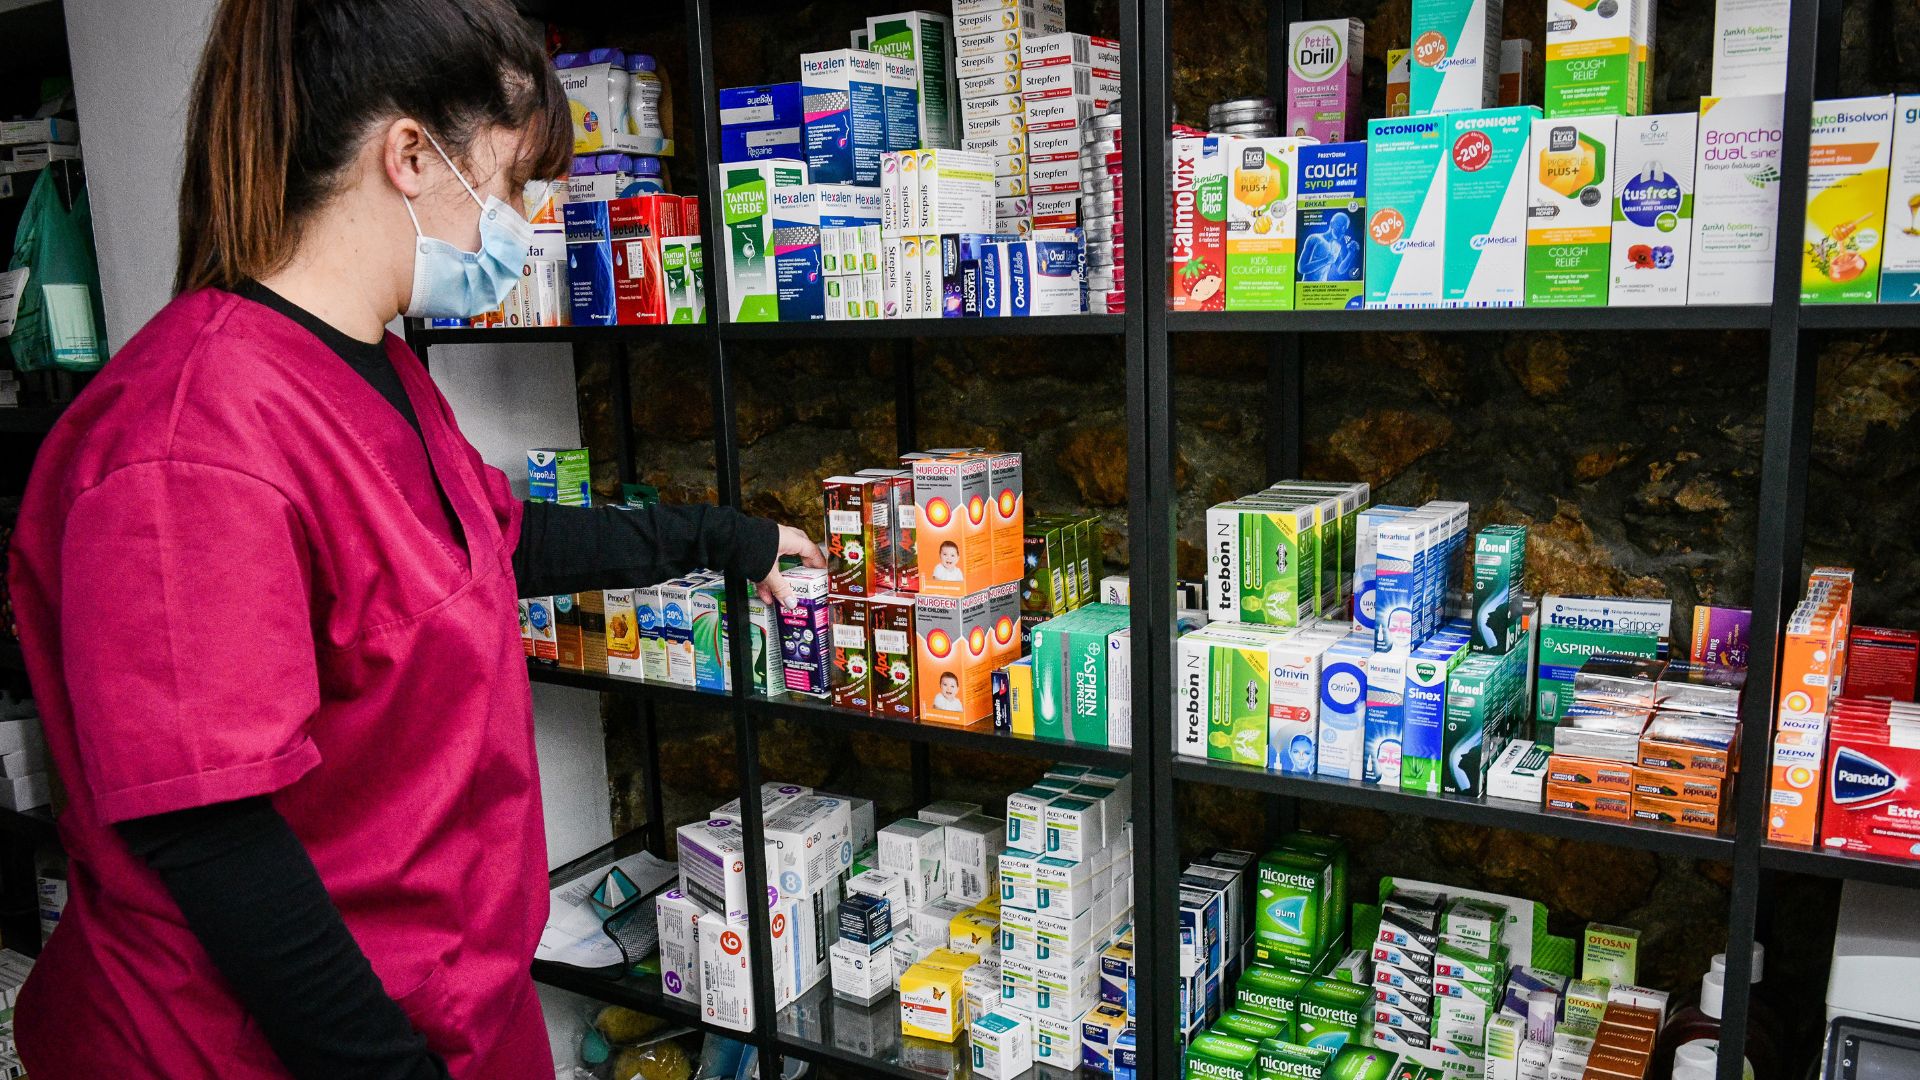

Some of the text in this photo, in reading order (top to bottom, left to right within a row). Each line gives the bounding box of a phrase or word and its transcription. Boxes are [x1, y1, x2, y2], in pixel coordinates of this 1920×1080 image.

[959, 15, 992, 26] Strepsils
[872, 42, 911, 53] TANTUM
[962, 36, 994, 48] Strepsils
[1305, 35, 1330, 48] Petit
[1026, 42, 1060, 55] Strepfen
[1416, 42, 1446, 58] 30%
[962, 56, 994, 68] Strepsils
[1301, 48, 1334, 65] Drill
[1450, 58, 1476, 66] Medical
[804, 58, 844, 72] Hexalen
[850, 56, 880, 70] Hexalen
[1566, 58, 1606, 72] COUGH
[886, 62, 914, 77] Hexalen
[1573, 70, 1598, 80] RELIEF
[964, 78, 994, 89] Strepsils
[1026, 74, 1060, 86] Strepfen
[967, 99, 998, 110] Strepsils
[1030, 106, 1064, 118] Strepfen
[968, 118, 1000, 130] Strepsils
[1455, 117, 1517, 130] OCTONION
[1375, 124, 1434, 136] OCTONION
[1706, 128, 1782, 145] Broncho
[968, 140, 998, 150] Strepsils
[1034, 138, 1068, 150] Strepfen
[748, 146, 773, 158] Regaine
[1704, 146, 1778, 161] dual sine
[1034, 169, 1068, 180] Strepfen
[1305, 163, 1358, 178] COUGH
[1304, 180, 1334, 190] syrup
[726, 192, 764, 203] TANTUM
[774, 192, 816, 205] Hexalen
[821, 191, 852, 204] Hexalen
[1624, 186, 1678, 200] tusfree
[856, 194, 881, 206] Hexale
[921, 184, 929, 228] Strepsils
[1037, 200, 1071, 212] Strepfen
[730, 202, 762, 214] VERDE
[1173, 158, 1194, 262] Calmovix
[614, 223, 650, 236] Botufex
[1372, 216, 1402, 238] 30%
[1407, 240, 1436, 248] Medical
[1488, 236, 1518, 244] Medical
[664, 250, 684, 260] TANTUM
[1548, 247, 1588, 258] COUGH
[1250, 256, 1268, 264] KIDS
[1556, 257, 1580, 268] RELIEF
[1232, 264, 1287, 274] COUGH RELIEF
[966, 269, 976, 312] Bisoral
[962, 462, 988, 475] NUROFEN
[992, 457, 1020, 470] NUROFEN
[529, 470, 556, 480] VapoRub
[916, 466, 956, 476] NUROFEN
[1380, 532, 1410, 542] Hexarhinal
[1478, 538, 1510, 554] Ronal
[1218, 542, 1231, 610] trebon
[990, 585, 1018, 598] NUROFEN
[918, 598, 956, 609] NUROFEN
[963, 594, 988, 608] NUROFEN
[1554, 643, 1606, 656] ASPIRIN
[1274, 668, 1310, 681] Otrivin
[1416, 668, 1436, 676] VICKS
[1084, 654, 1096, 716] ASPIRIN
[1331, 682, 1358, 694] Otrivin
[1450, 679, 1484, 696] Ronal
[1076, 672, 1084, 718] EXPRESS
[1408, 687, 1441, 702] Sinex
[1186, 673, 1200, 744] trebon
[1784, 721, 1820, 730] DEPON
[1778, 748, 1815, 758] DEPON
[1839, 770, 1889, 786] Panadol
[1683, 788, 1718, 800] Panadol
[1888, 804, 1920, 818] Extr
[1682, 814, 1715, 826] Panadol
[1260, 868, 1316, 888] nicorette
[1276, 908, 1296, 918] gum
[1588, 936, 1632, 950] OTOSAN
[1104, 958, 1122, 966] Contour
[1262, 972, 1300, 984] nicorette
[1326, 984, 1365, 995] nicorette
[1238, 990, 1294, 1011] nicorette
[1568, 998, 1603, 1011] OTOSAN
[1301, 1002, 1358, 1024] nicorette
[1086, 1024, 1102, 1032] Contour
[1240, 1016, 1276, 1029] nicorette
[1214, 1040, 1252, 1052] nicorette
[1190, 1058, 1244, 1080] nicorette
[1260, 1056, 1322, 1079] nicorette
[1442, 1060, 1476, 1073] HERB
